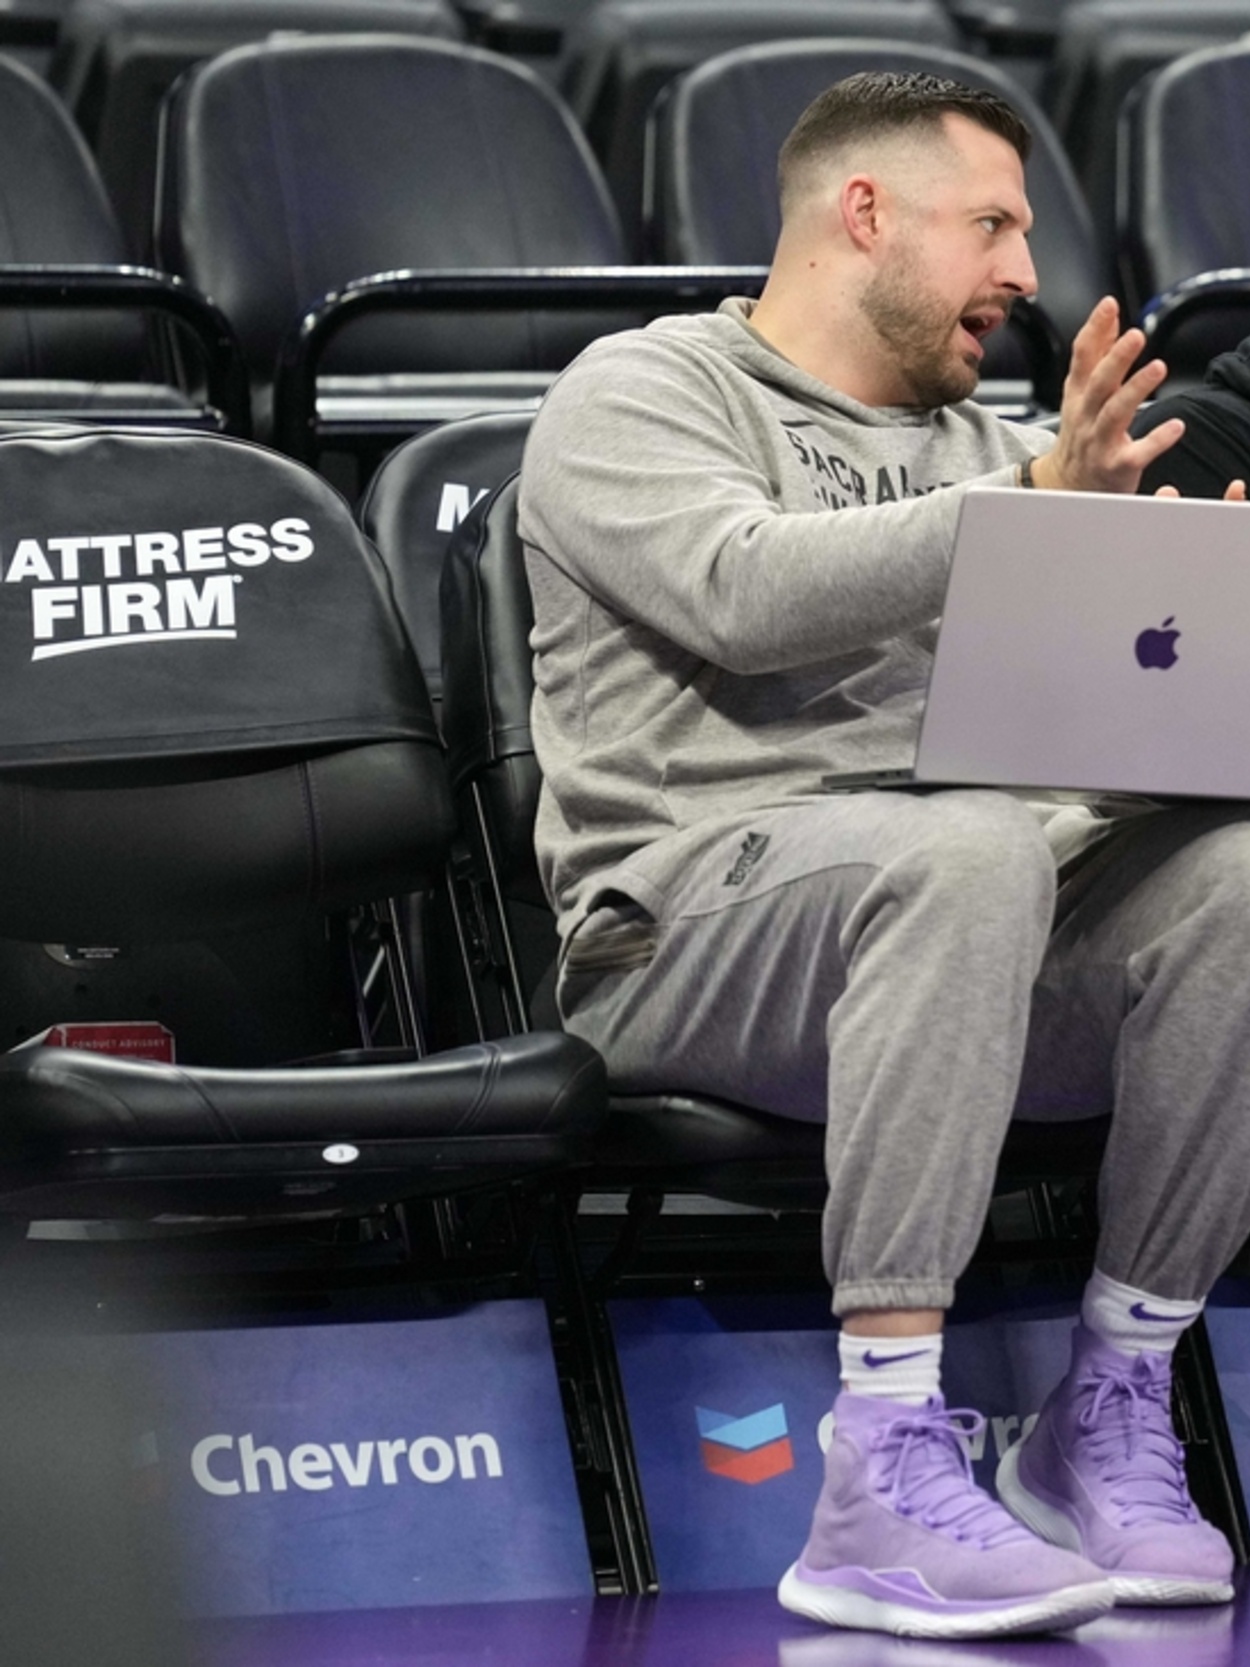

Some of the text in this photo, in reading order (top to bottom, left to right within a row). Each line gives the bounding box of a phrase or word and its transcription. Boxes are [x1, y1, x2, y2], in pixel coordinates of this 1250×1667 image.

[0, 518, 314, 583] ATTRESS
[31, 575, 238, 638] FIRM
[190, 1432, 503, 1495] Chevron
